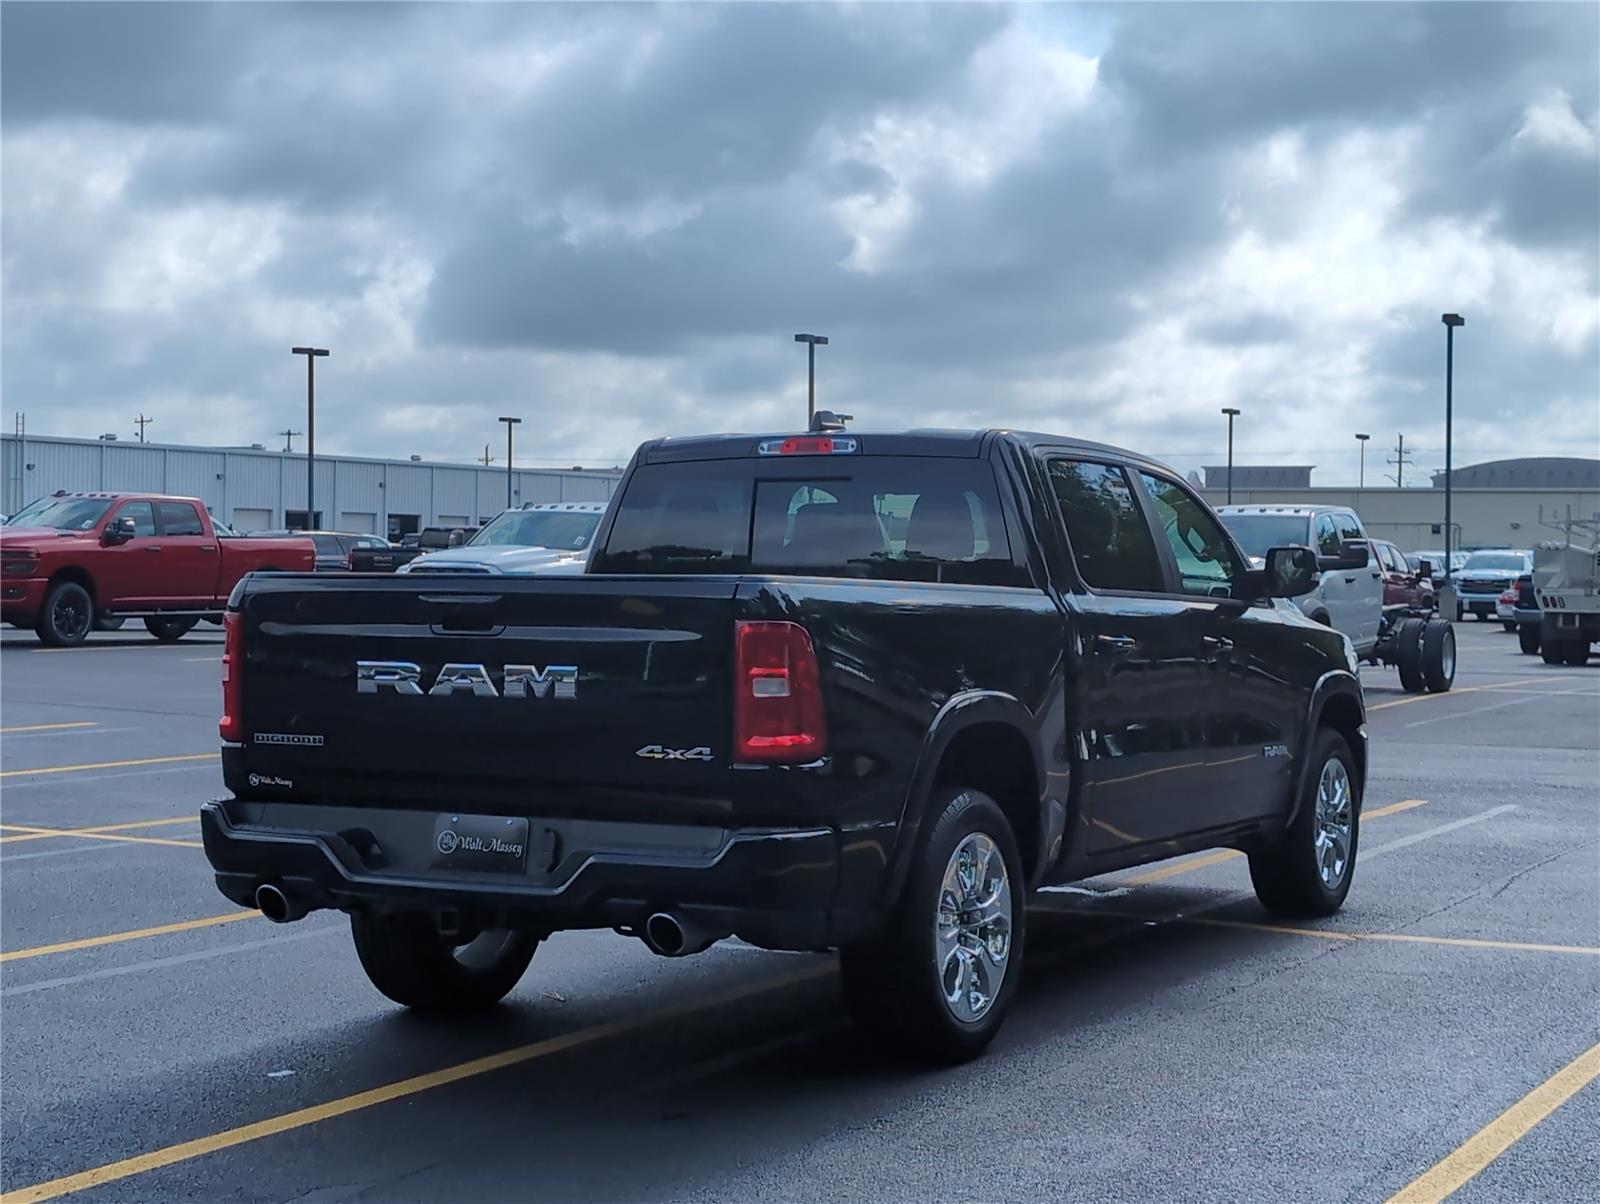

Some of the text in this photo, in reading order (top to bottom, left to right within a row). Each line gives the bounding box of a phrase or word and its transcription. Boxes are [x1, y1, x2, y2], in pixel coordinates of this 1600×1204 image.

[356, 660, 578, 699] RAM
[254, 733, 324, 746] BIGHORN
[457, 836, 482, 851] Walt
[482, 839, 523, 858] Massey
